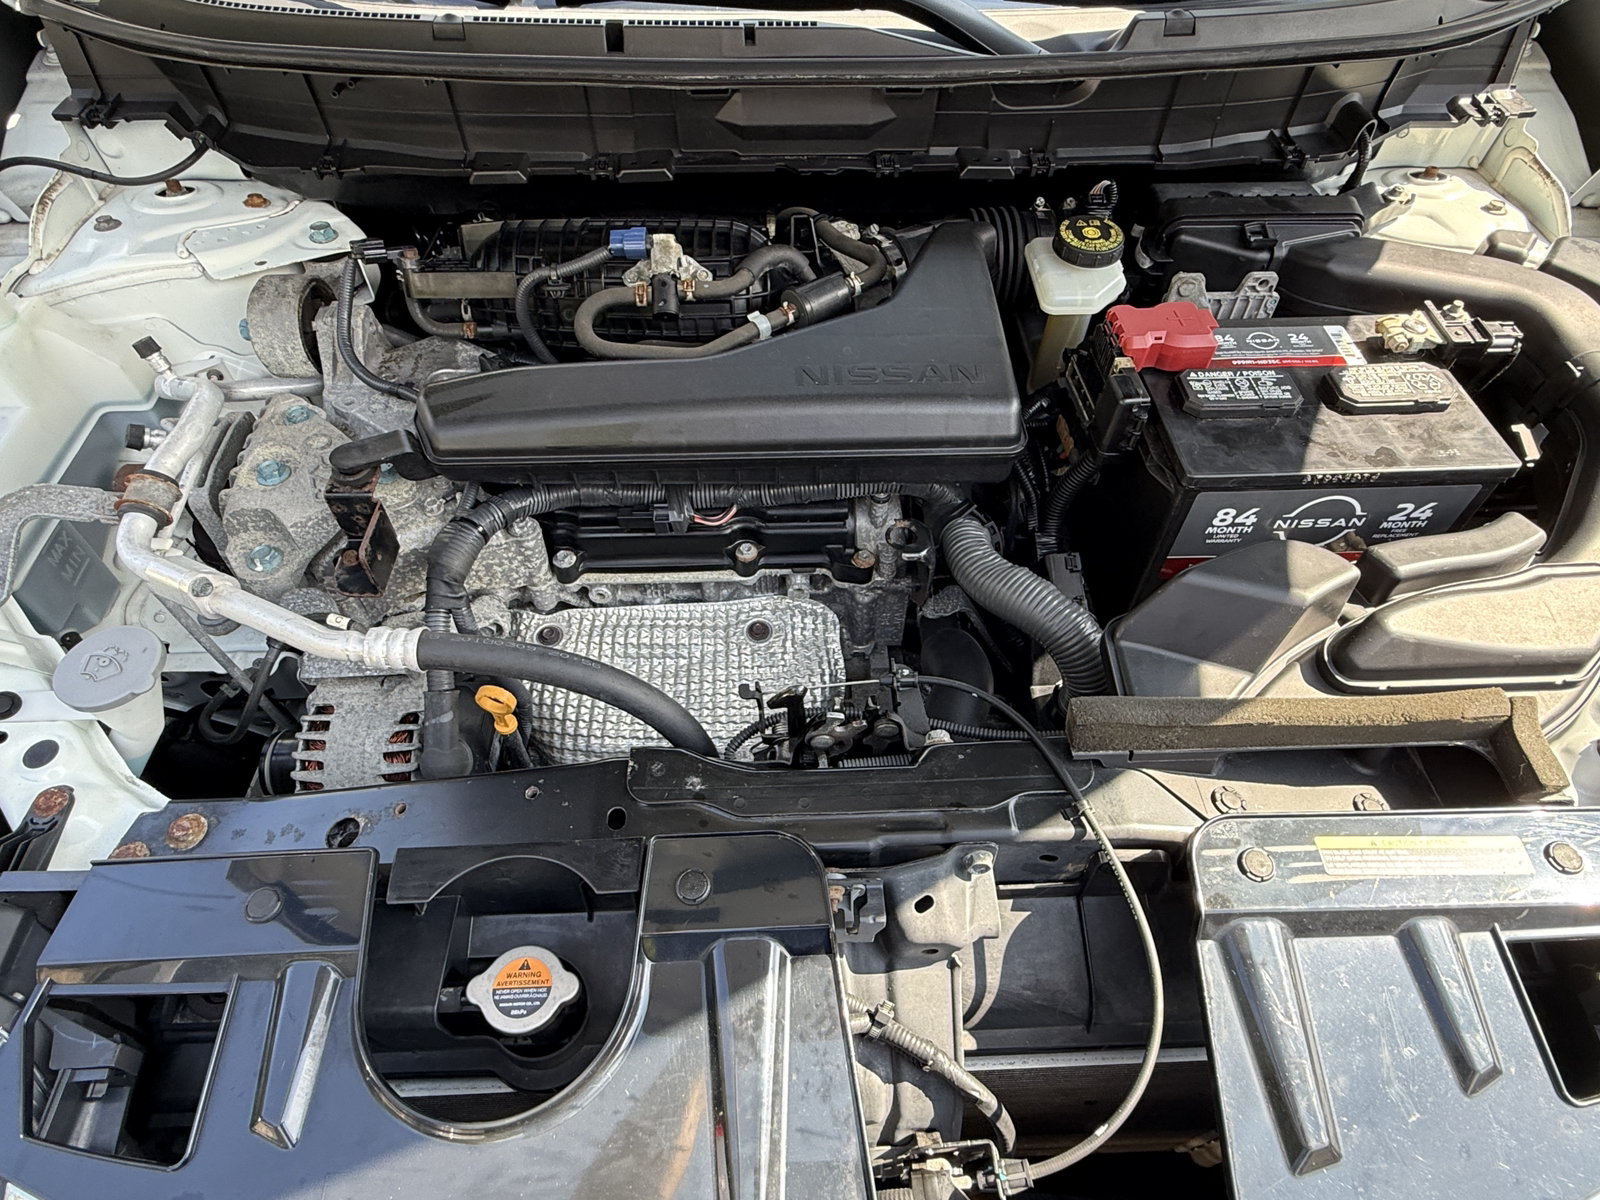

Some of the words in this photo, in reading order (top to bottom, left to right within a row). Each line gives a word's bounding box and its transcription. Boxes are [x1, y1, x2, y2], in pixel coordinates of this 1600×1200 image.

[1287, 333, 1309, 341] 24
[797, 364, 986, 386] NISSAN
[1212, 508, 1261, 526] 84
[1387, 502, 1439, 521] 24
[1273, 517, 1367, 529] NISSAN
[1379, 520, 1428, 529] MONTH
[1205, 526, 1254, 534] MONTH
[46, 530, 72, 567] MAX
[61, 544, 86, 582] MIN
[506, 971, 542, 979] WARNING
[496, 979, 550, 987] AVERTISSEMENT
